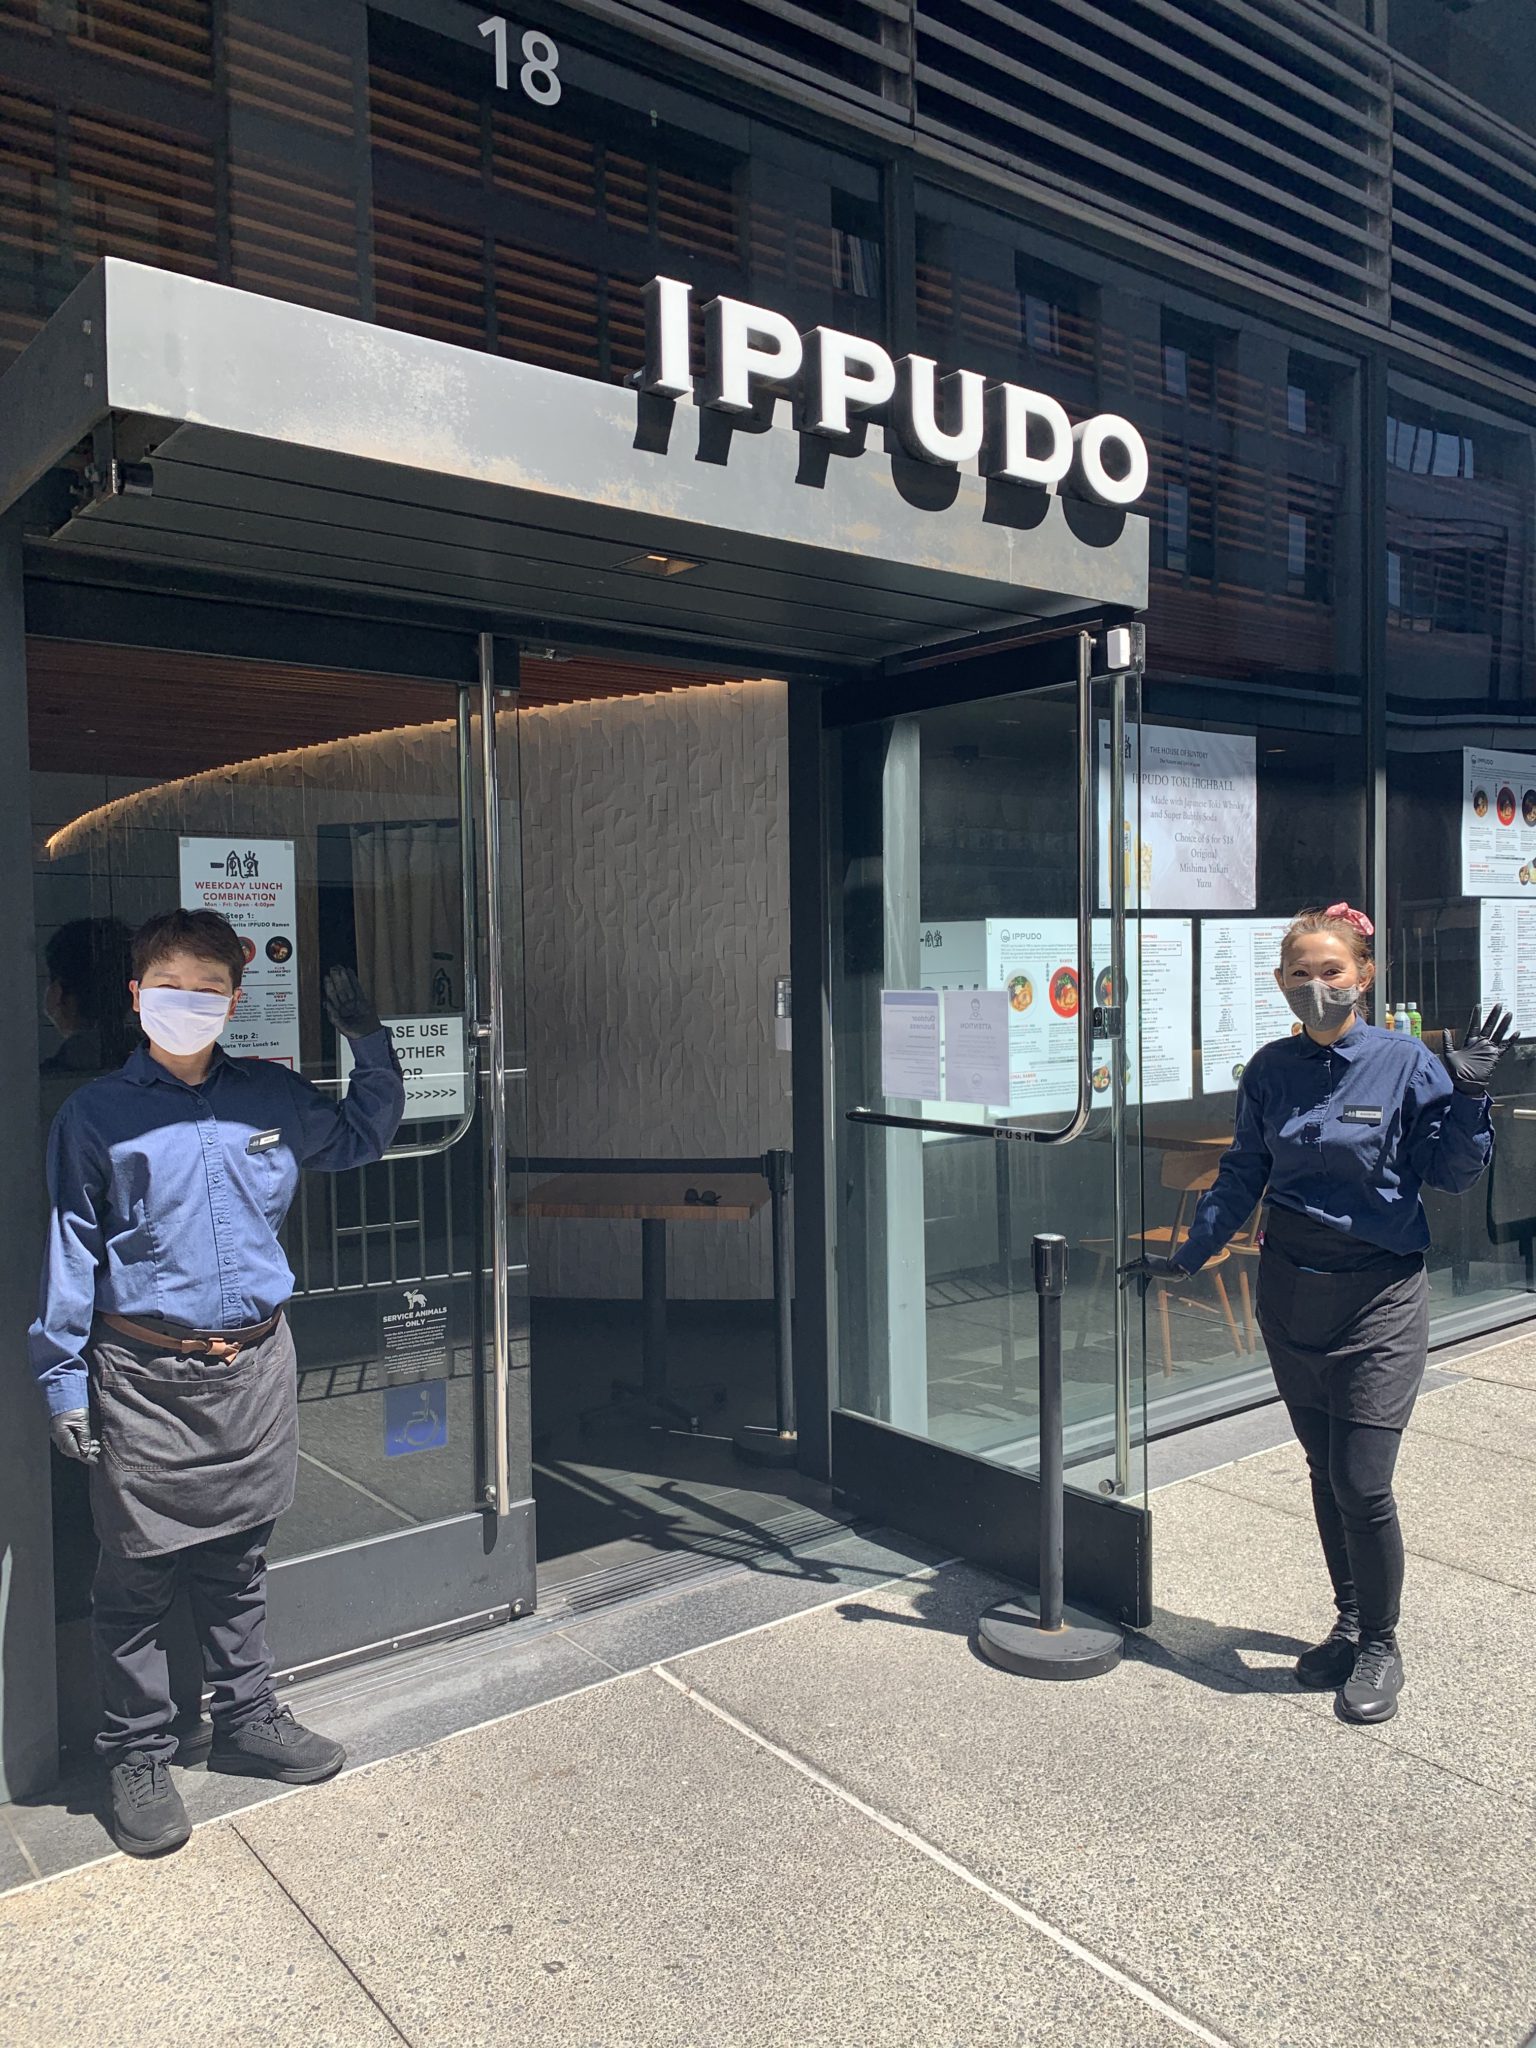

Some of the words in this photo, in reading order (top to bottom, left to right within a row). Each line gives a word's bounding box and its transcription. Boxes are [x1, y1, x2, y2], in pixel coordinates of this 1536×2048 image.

[478, 15, 562, 106] 18
[643, 275, 1149, 504] IPPUDO
[1150, 745, 1160, 754] THE
[1161, 747, 1179, 756] HOUSE
[1132, 773, 1168, 785] IPUDO
[1171, 776, 1190, 787] TOKI
[1192, 778, 1235, 791] HIGHBALL
[1151, 795, 1168, 805] Made
[1169, 796, 1183, 806] with
[1209, 799, 1221, 809] Toki
[1222, 800, 1244, 813] Whisky
[1151, 810, 1162, 819] and
[1164, 810, 1181, 821] Super
[1203, 813, 1217, 822] Soda
[1174, 832, 1197, 843] Choice
[1190, 848, 1217, 861] Original
[1179, 863, 1207, 873] Mishima
[195, 881, 245, 890] WEEKDAY
[249, 882, 283, 890] LUNCH
[1197, 877, 1212, 888] Yuzu
[203, 892, 276, 901] COMBINATION
[225, 912, 244, 920] Step
[420, 1024, 448, 1037] USE
[230, 1033, 248, 1041] Step
[395, 1045, 445, 1060] OTHER
[996, 1129, 1032, 1141] PUSH
[383, 1312, 414, 1322] SERVICE
[415, 1306, 447, 1317] ANIMALS
[405, 1319, 425, 1327] ONLY
